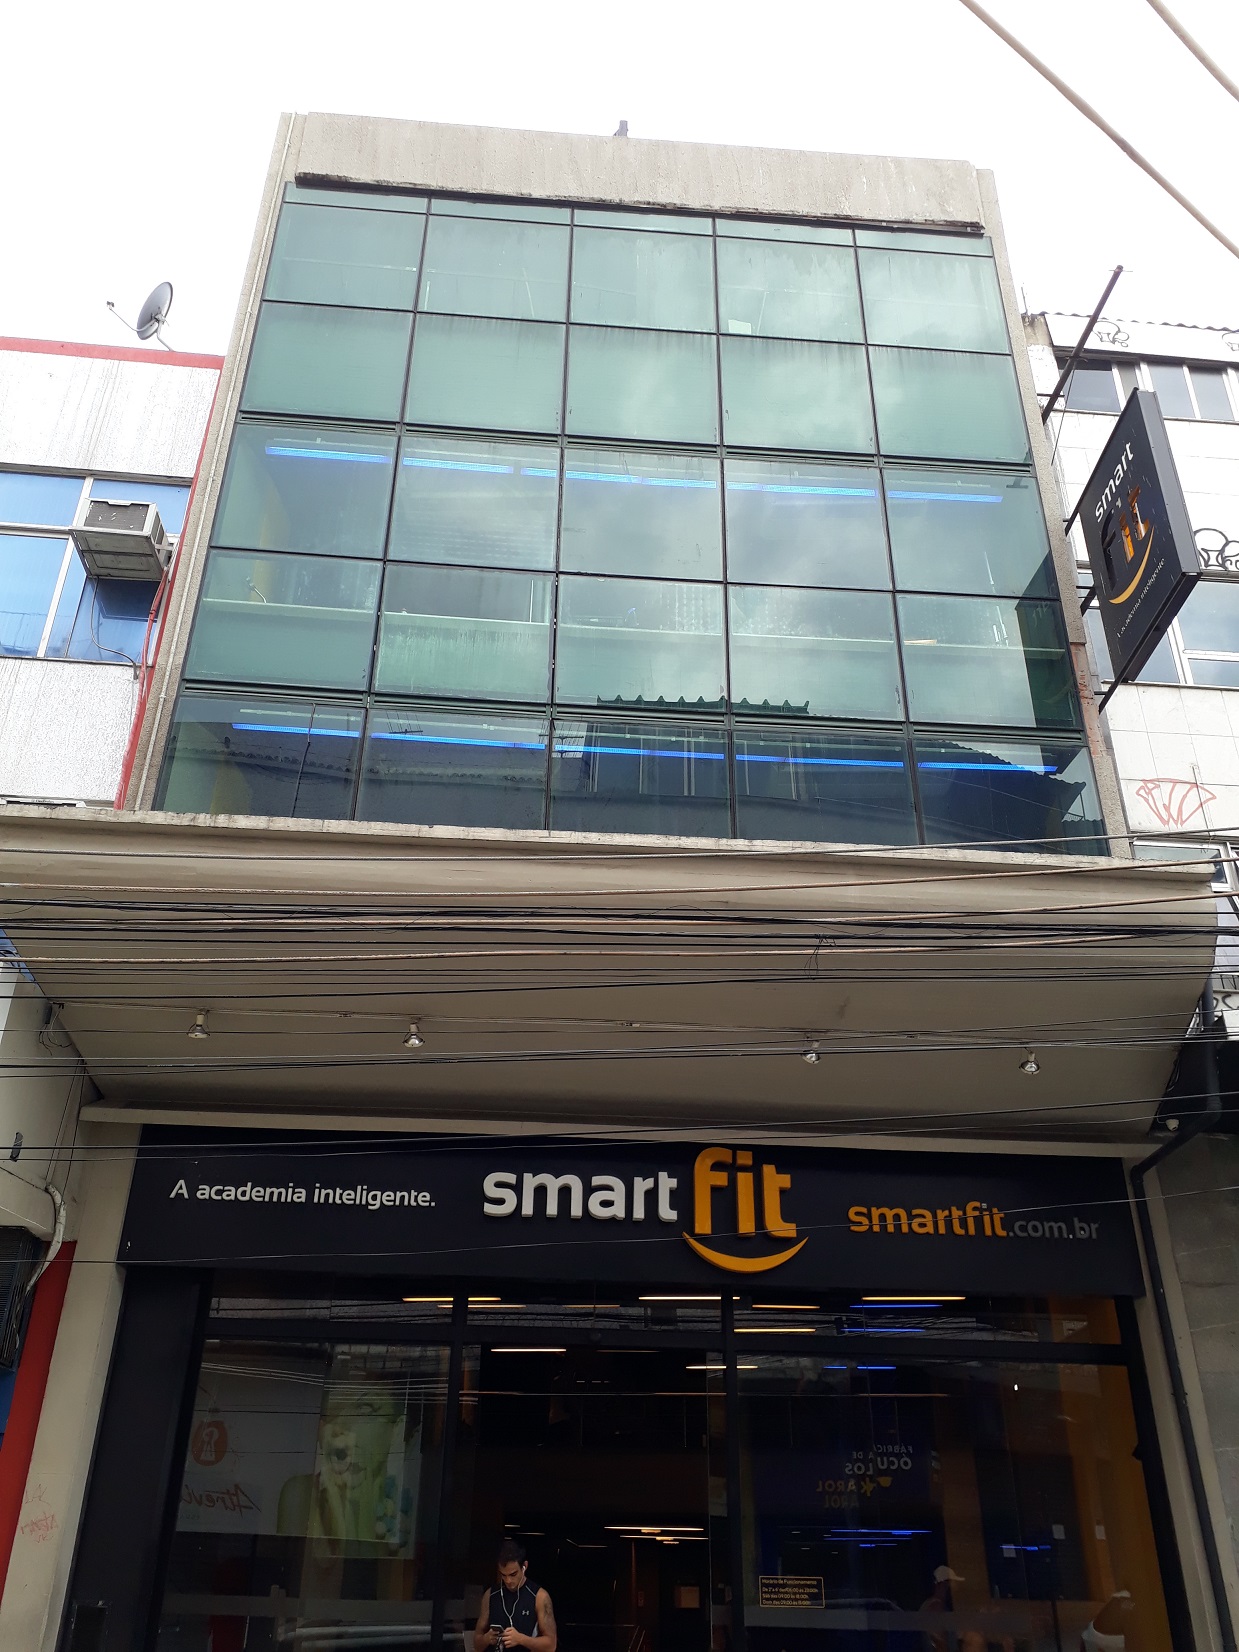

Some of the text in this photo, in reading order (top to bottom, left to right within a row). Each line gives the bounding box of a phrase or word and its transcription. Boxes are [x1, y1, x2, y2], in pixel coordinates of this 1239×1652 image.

[1095, 441, 1134, 523] smart
[169, 1179, 437, 1210] A academia inteligente.
[482, 1146, 798, 1239] smart fit
[847, 1200, 1100, 1240] smartfit.com.br
